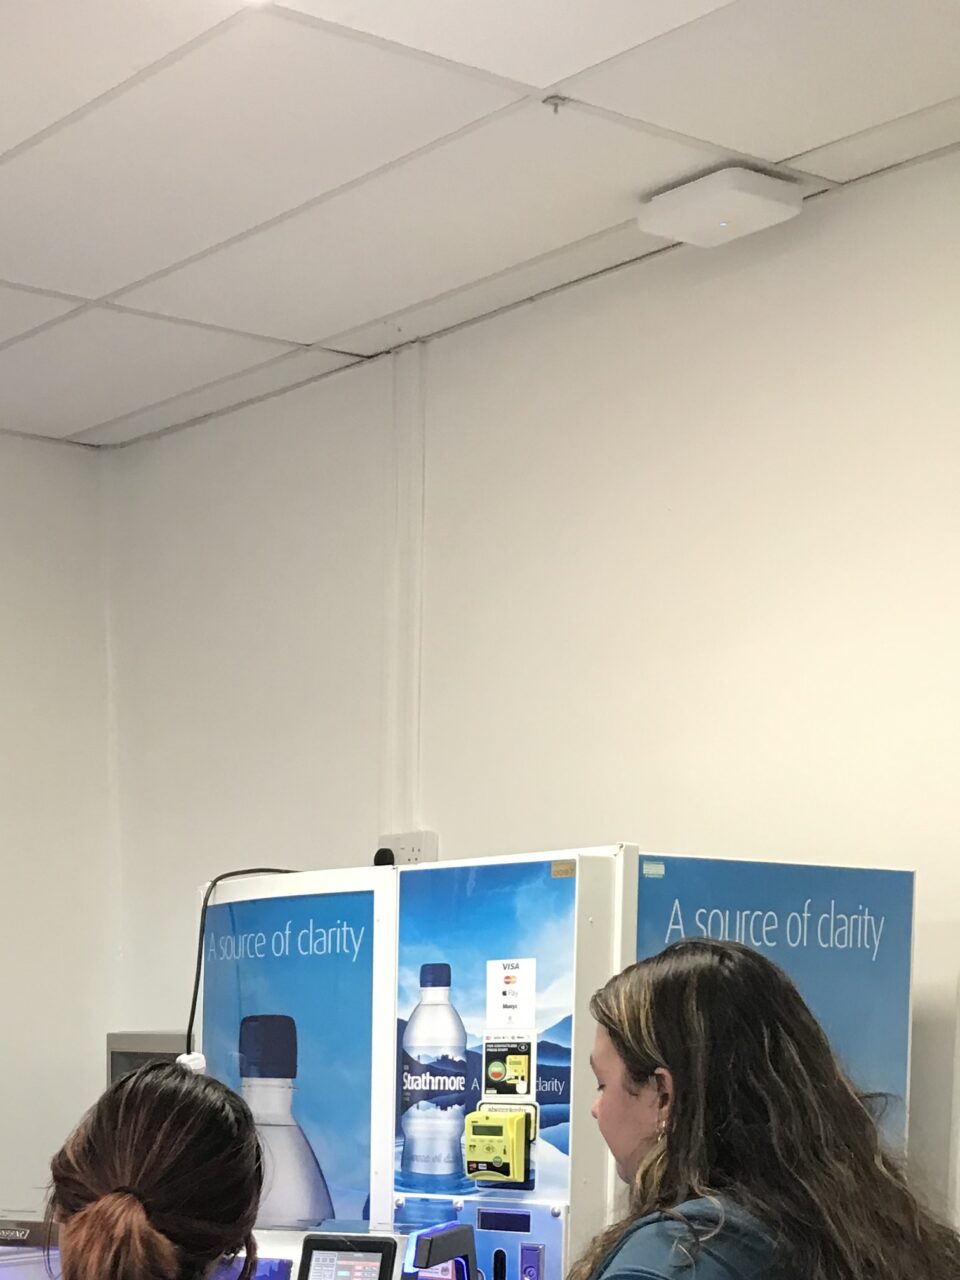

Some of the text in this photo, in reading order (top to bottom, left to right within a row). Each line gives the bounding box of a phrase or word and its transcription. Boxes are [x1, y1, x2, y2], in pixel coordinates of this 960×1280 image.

[665, 898, 885, 961] A source of clarity
[207, 918, 365, 962] A source of clarity
[502, 962, 520, 971] VISA
[403, 1071, 465, 1091] Strathmore
[471, 1077, 480, 1090] A
